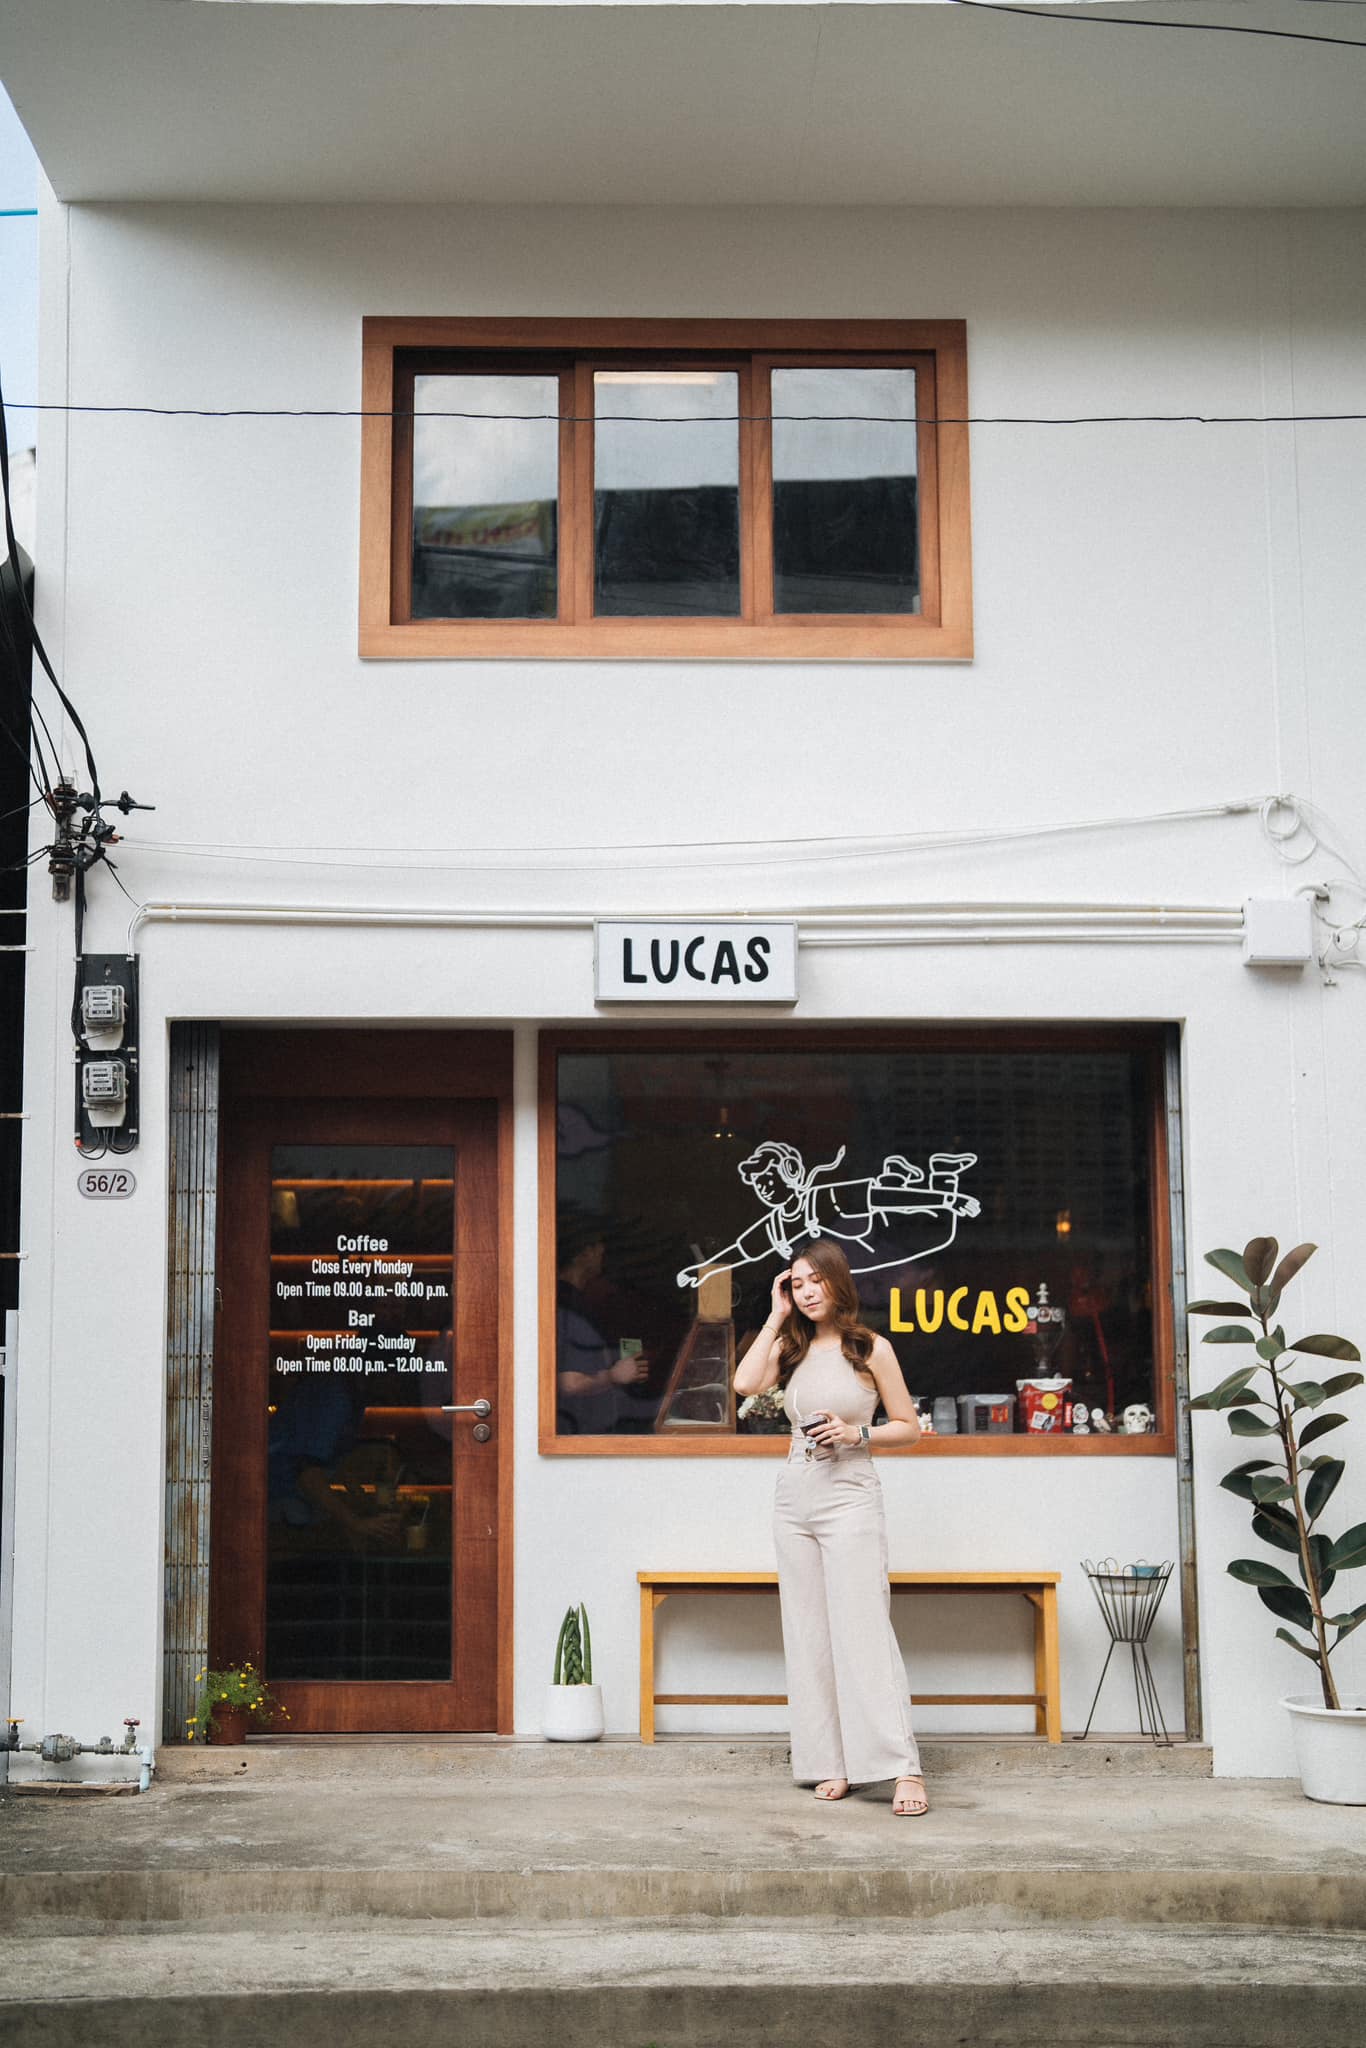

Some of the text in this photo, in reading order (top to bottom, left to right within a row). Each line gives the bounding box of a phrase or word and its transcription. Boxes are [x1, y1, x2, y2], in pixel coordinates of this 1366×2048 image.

[623, 936, 771, 984] LUCAS
[86, 1175, 128, 1193] 56/2
[337, 1235, 388, 1251] Coffee
[312, 1259, 413, 1278] Close Every Monday
[277, 1282, 302, 1300] Open
[305, 1281, 331, 1297] Time
[333, 1282, 362, 1296] 09.00
[395, 1282, 424, 1297] 06.00
[426, 1285, 448, 1300] p.m.
[348, 1310, 375, 1326] Bar
[890, 1286, 1030, 1334] LUCAS
[306, 1334, 332, 1352] Open
[335, 1334, 368, 1353] Friday
[377, 1334, 416, 1353] Sunday
[276, 1357, 302, 1375] Open
[305, 1357, 331, 1372] Time
[333, 1357, 362, 1372] 08.00
[365, 1360, 387, 1376] p.m.
[425, 1360, 447, 1372] a.m.
